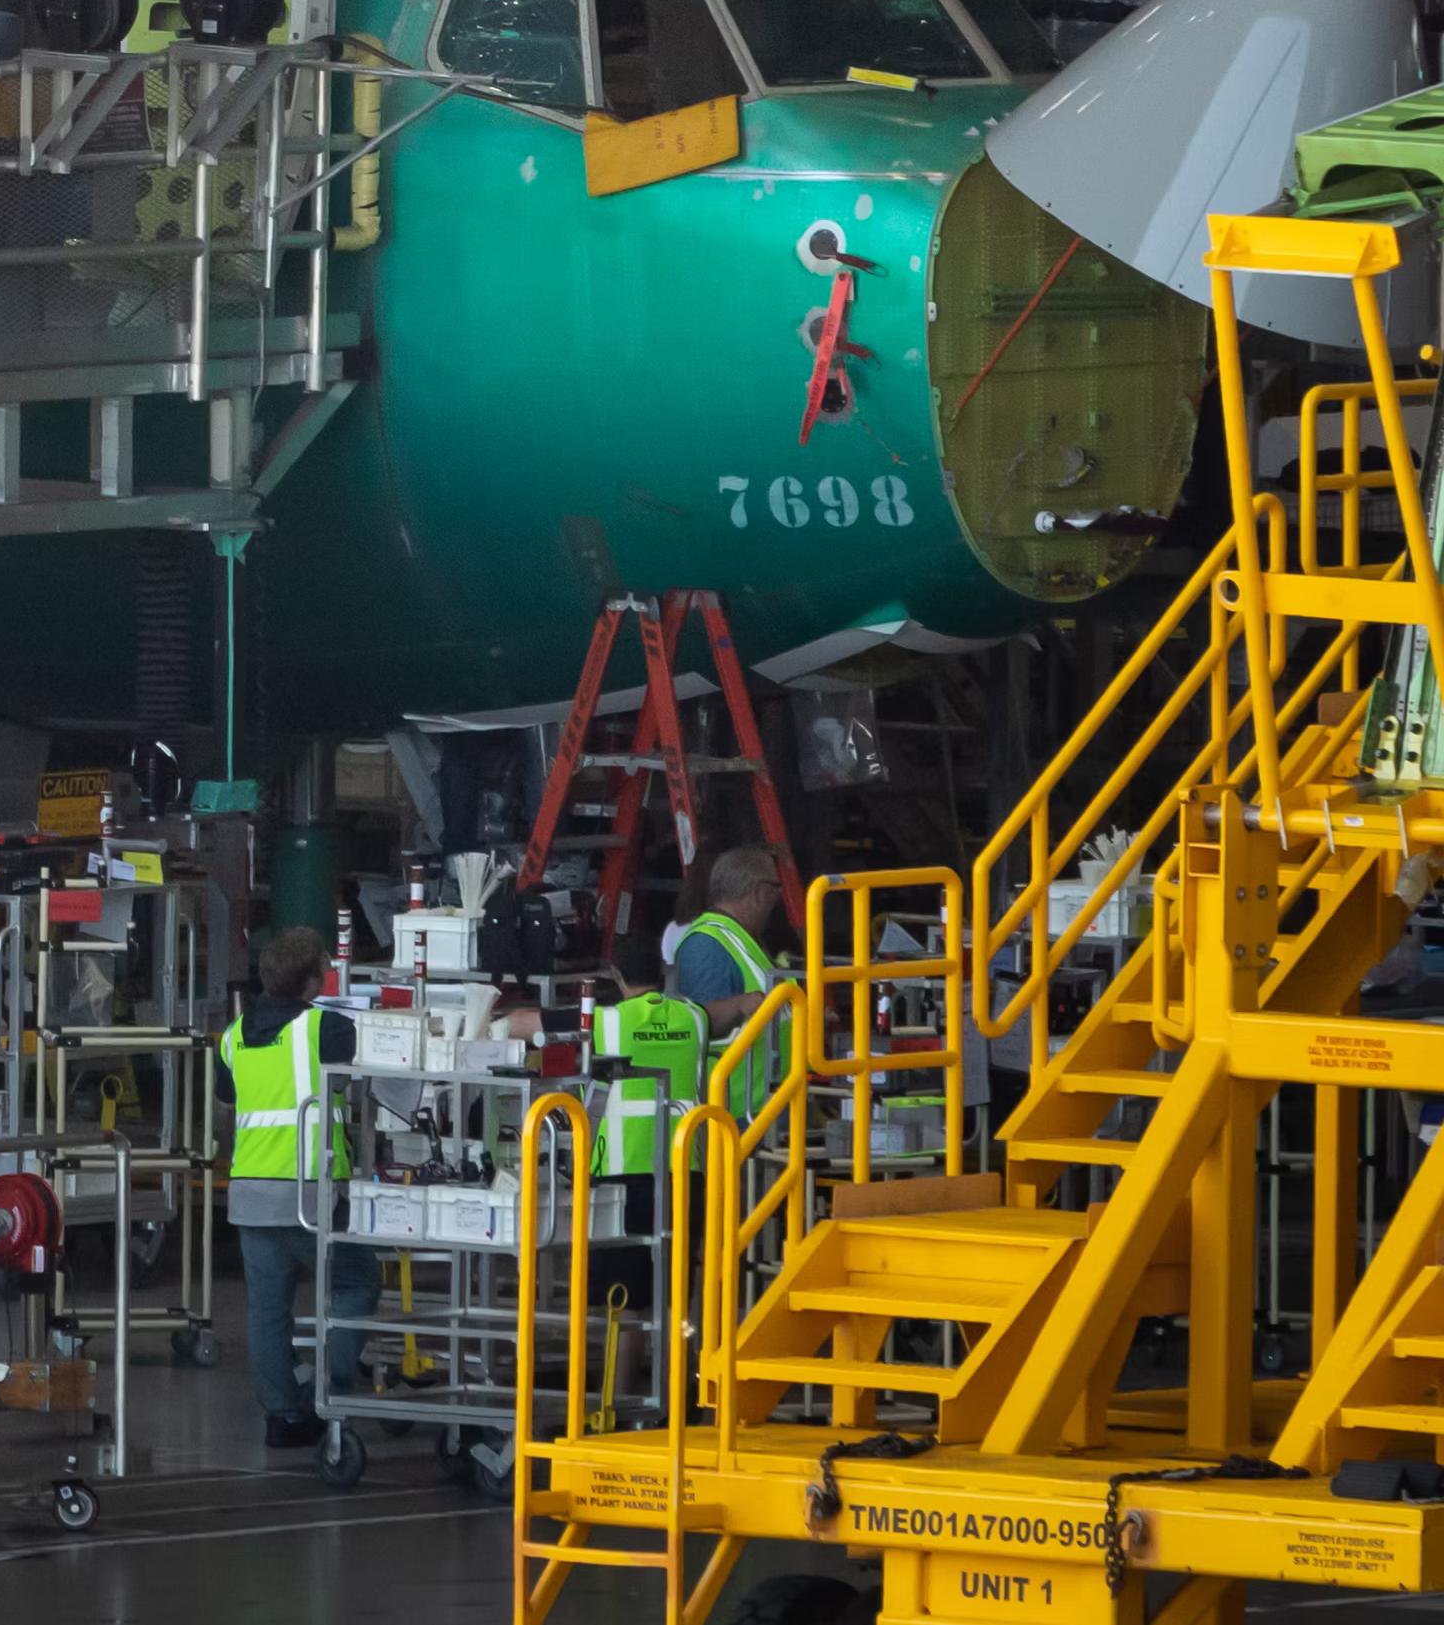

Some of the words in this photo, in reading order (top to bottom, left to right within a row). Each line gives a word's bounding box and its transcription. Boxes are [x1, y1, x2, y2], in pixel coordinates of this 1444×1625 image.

[718, 475, 915, 528] 7698
[42, 776, 107, 797] CAUTION
[593, 1471, 626, 1483] TRANS.
[591, 1485, 636, 1497] VERTICAL
[575, 1496, 587, 1507] IN
[590, 1497, 621, 1509] PLANT
[624, 1500, 668, 1512] HANDLIN
[961, 1571, 1029, 1604] UNIT
[1040, 1580, 1054, 1605] 1
